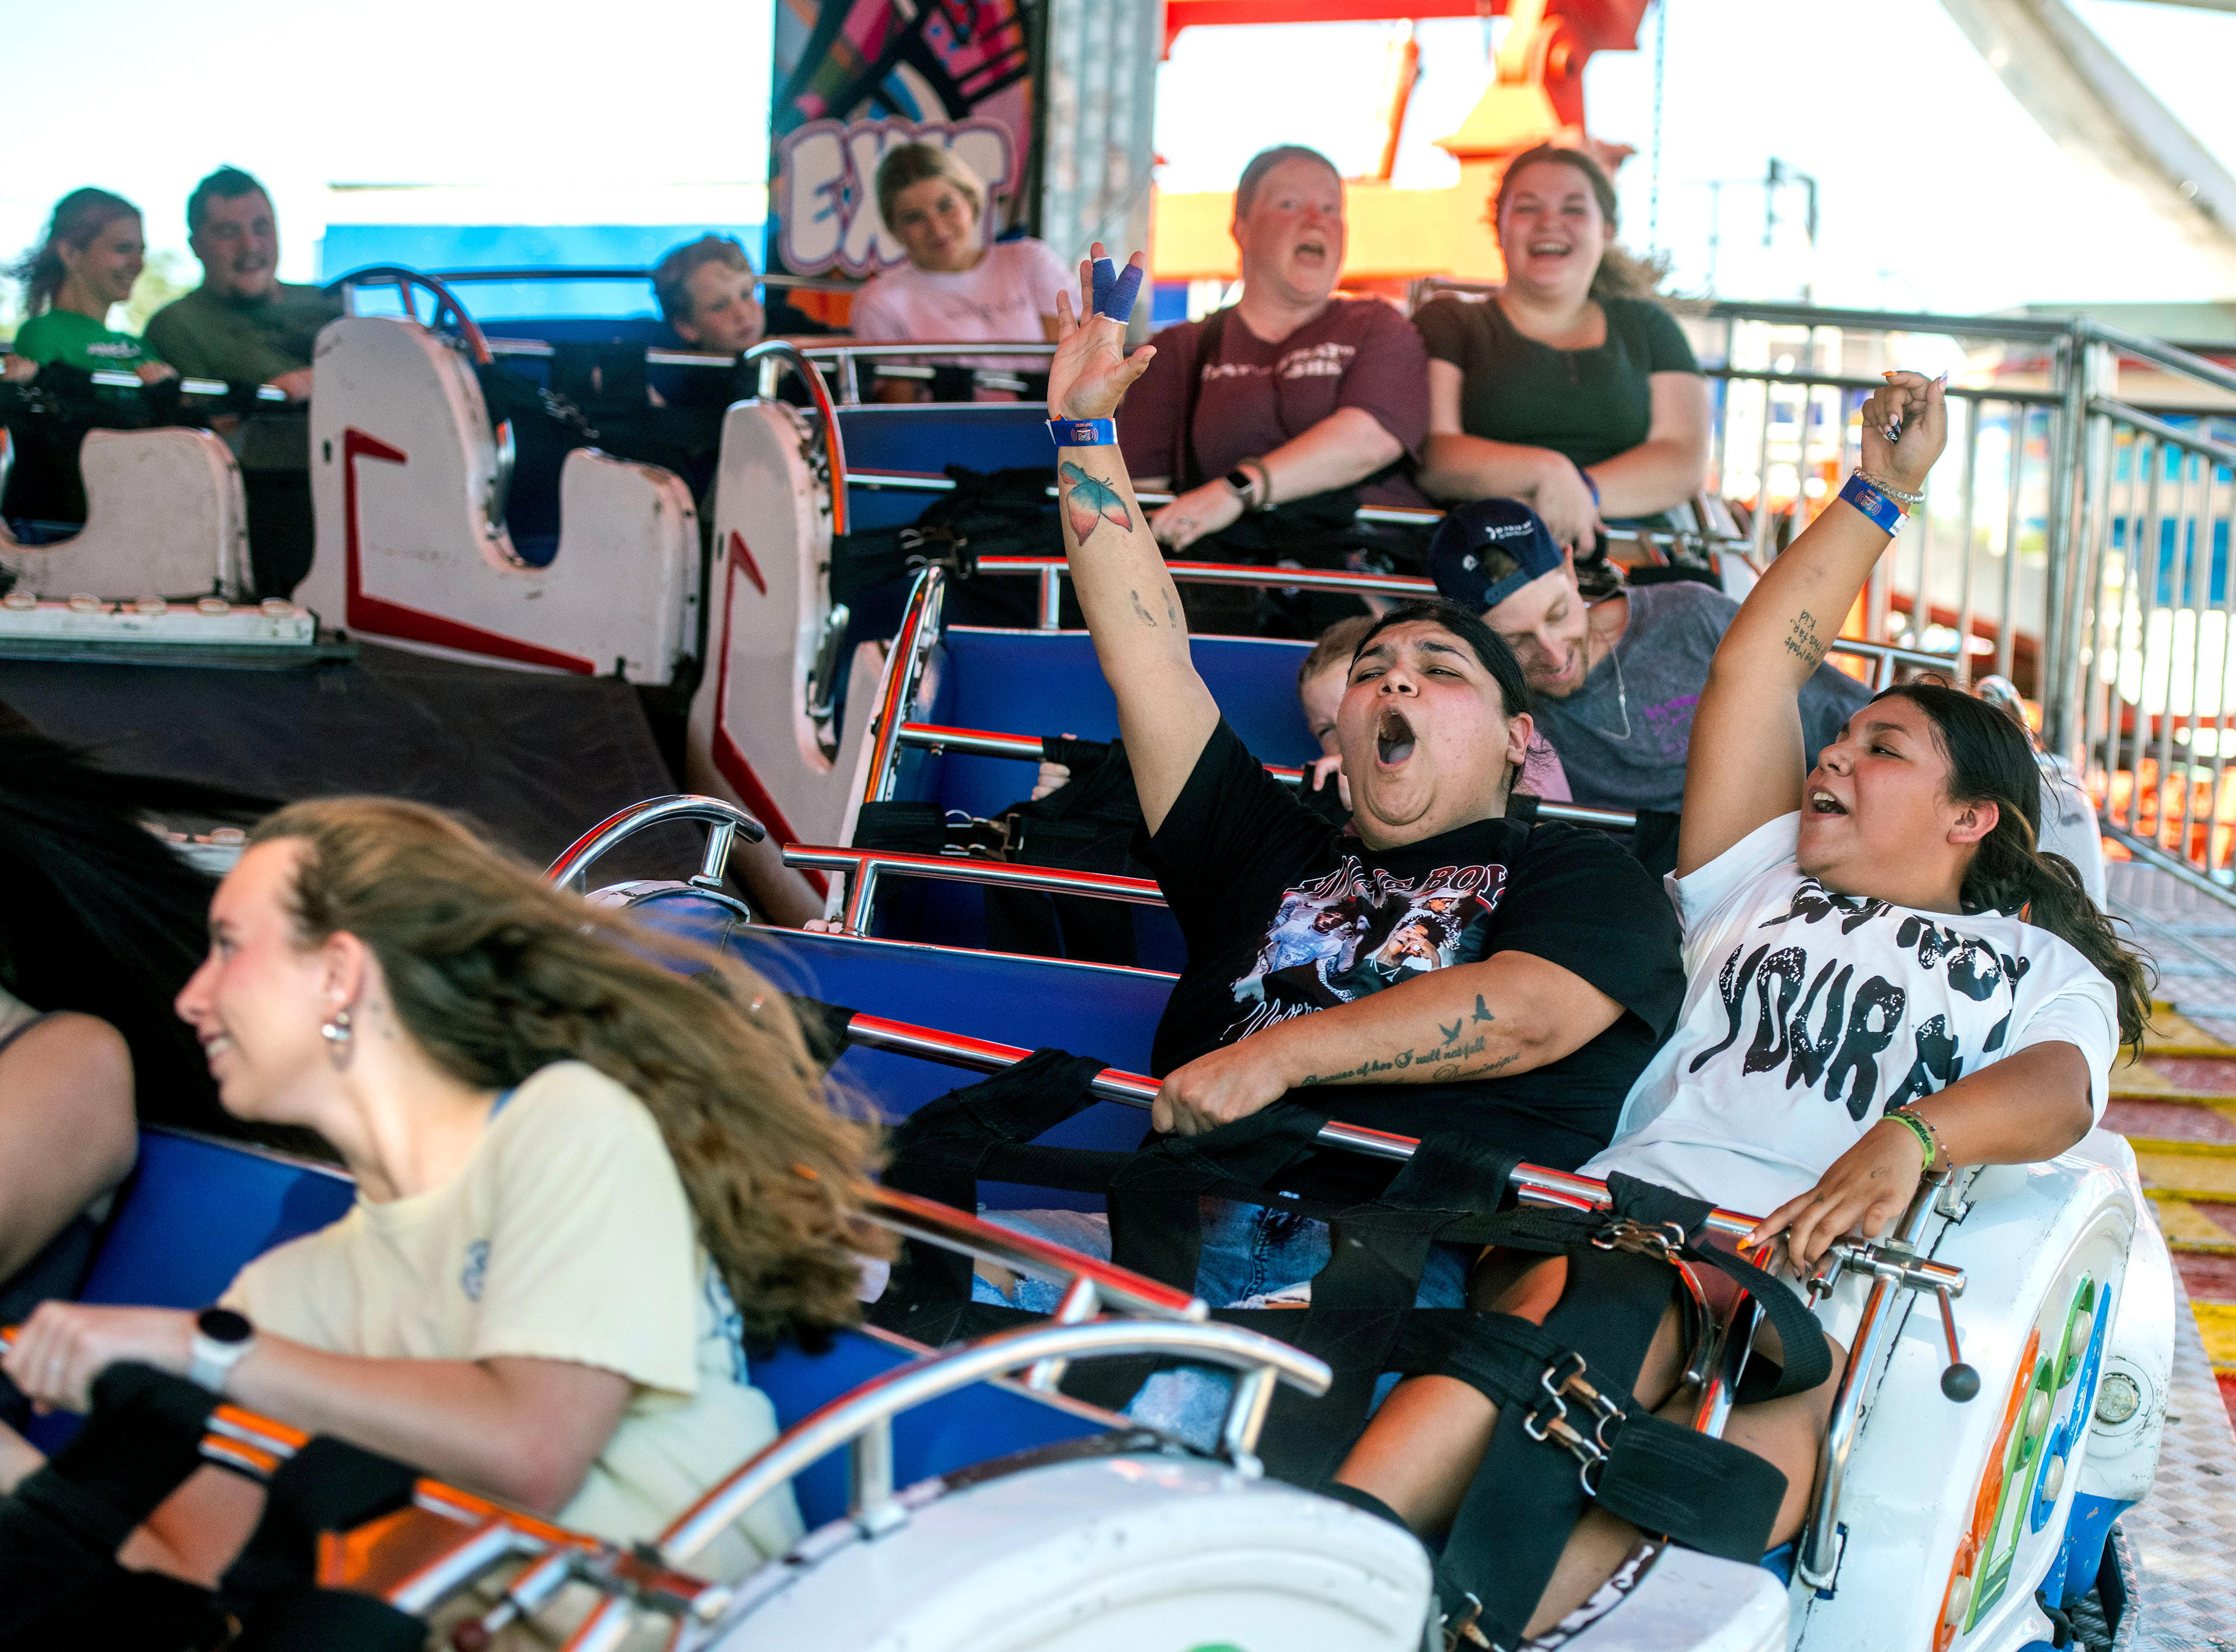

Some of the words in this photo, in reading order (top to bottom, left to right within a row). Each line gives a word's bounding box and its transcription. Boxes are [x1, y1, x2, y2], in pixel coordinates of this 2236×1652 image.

[786, 126, 1008, 267] EXT
[1356, 1061, 1369, 1077] of
[1394, 1048, 1415, 1069] I
[1416, 1048, 1441, 1064] will
[1443, 1046, 1463, 1060] not
[1462, 1035, 1486, 1060] fall
[1689, 943, 1906, 1121] YOUR
